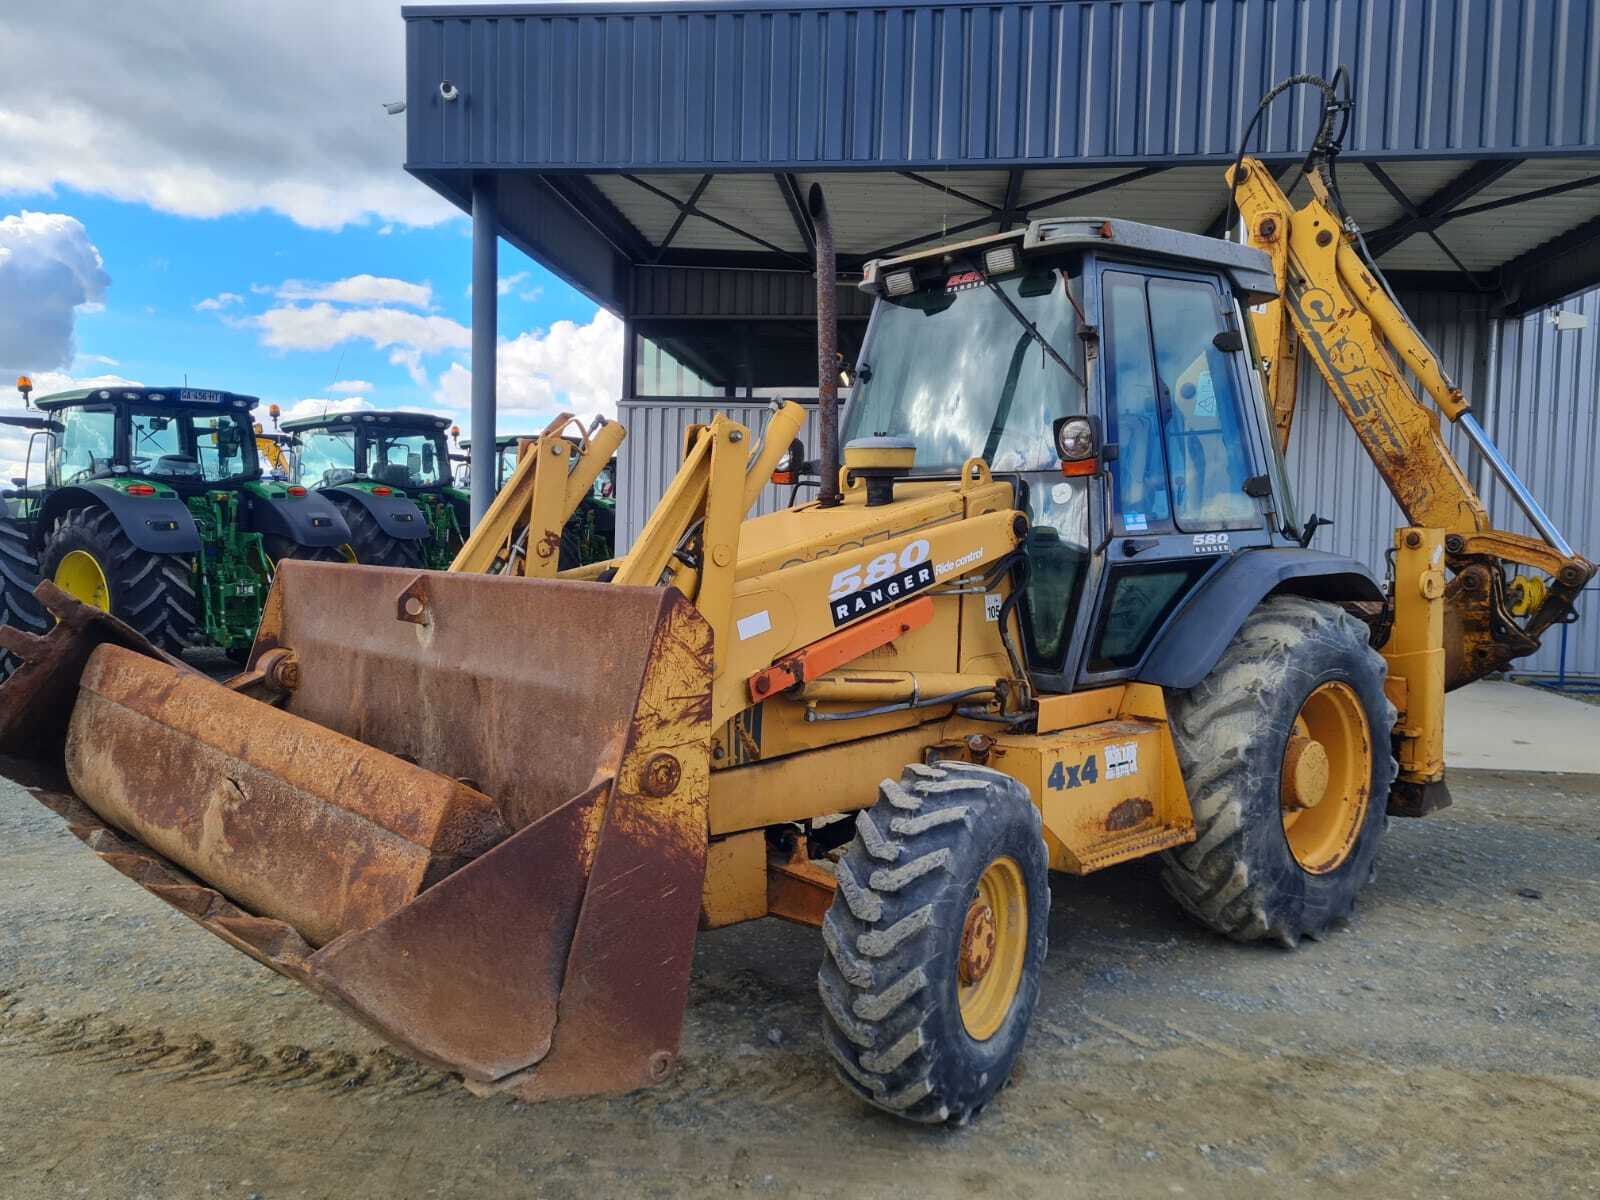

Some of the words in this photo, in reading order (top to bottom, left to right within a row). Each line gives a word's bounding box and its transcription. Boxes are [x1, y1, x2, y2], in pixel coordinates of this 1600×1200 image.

[1192, 533, 1229, 545] 580
[827, 539, 930, 600] 580
[935, 559, 955, 577] Ride
[954, 546, 984, 569] control
[836, 568, 931, 620] RANGER
[1047, 754, 1098, 791] 4x4
